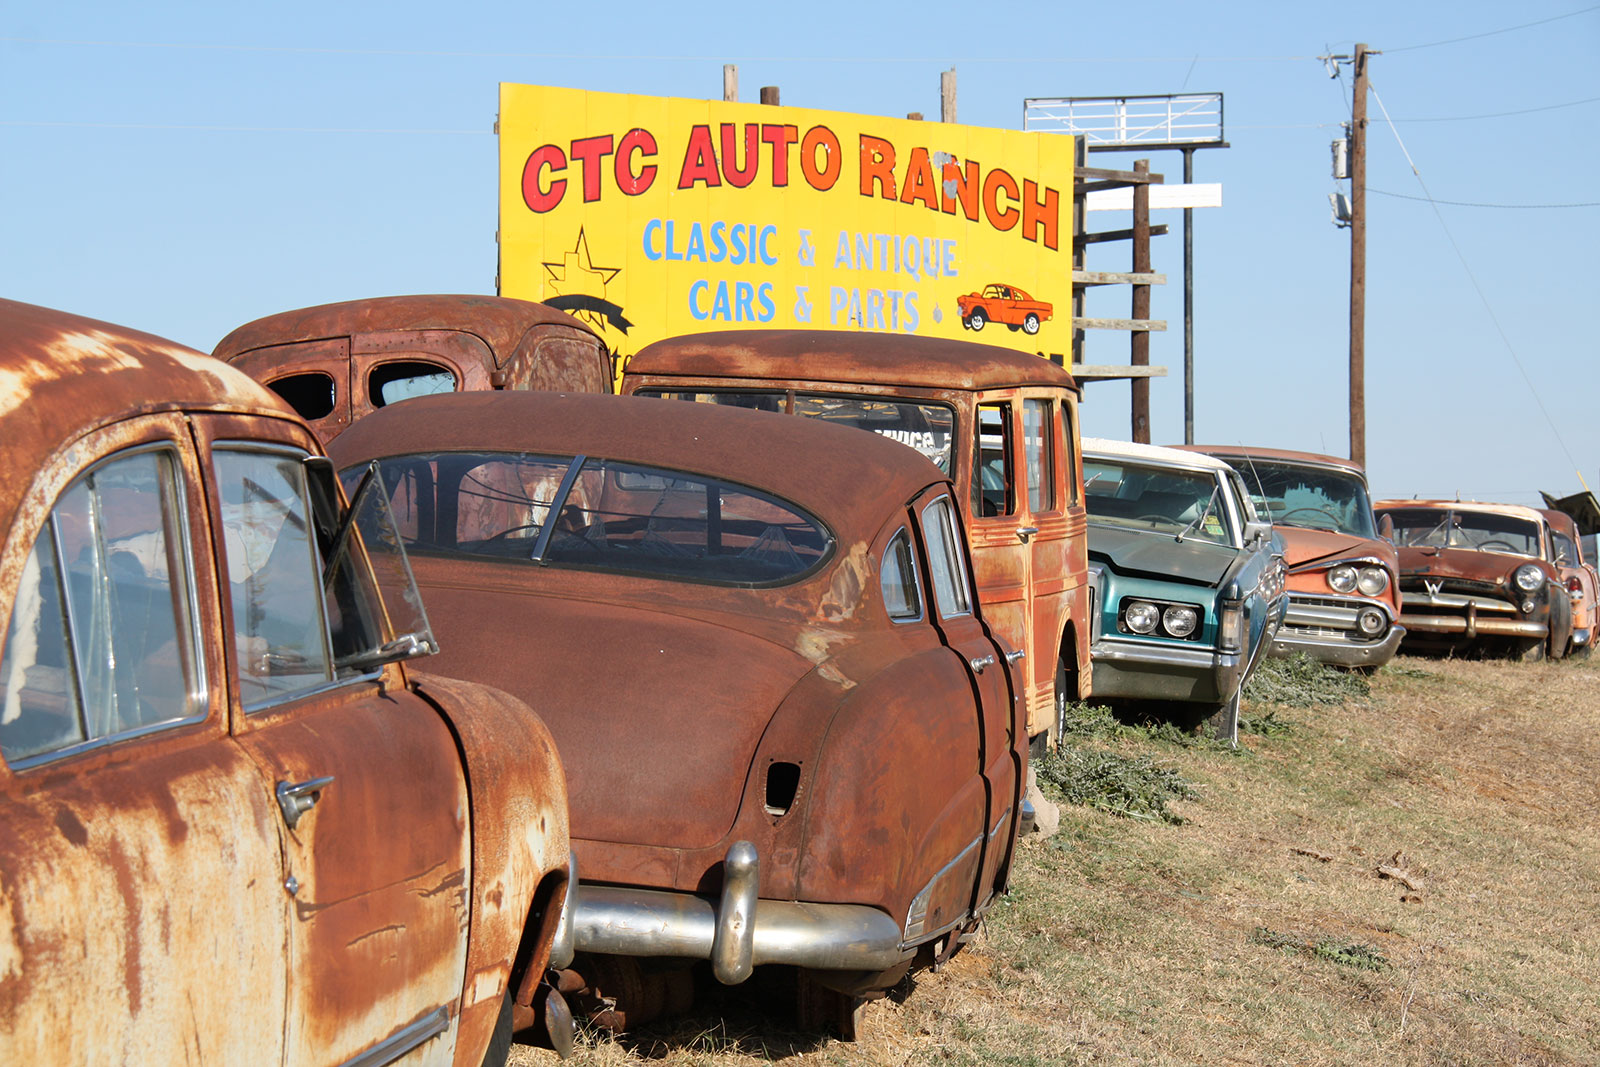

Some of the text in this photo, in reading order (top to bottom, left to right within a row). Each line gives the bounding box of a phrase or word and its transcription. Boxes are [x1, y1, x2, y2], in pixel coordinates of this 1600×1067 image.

[521, 122, 1060, 252] CTC AUTO RANCH
[642, 218, 959, 282] CLASSIC & ANTIQUE
[688, 279, 921, 332] CARS & PARTS
